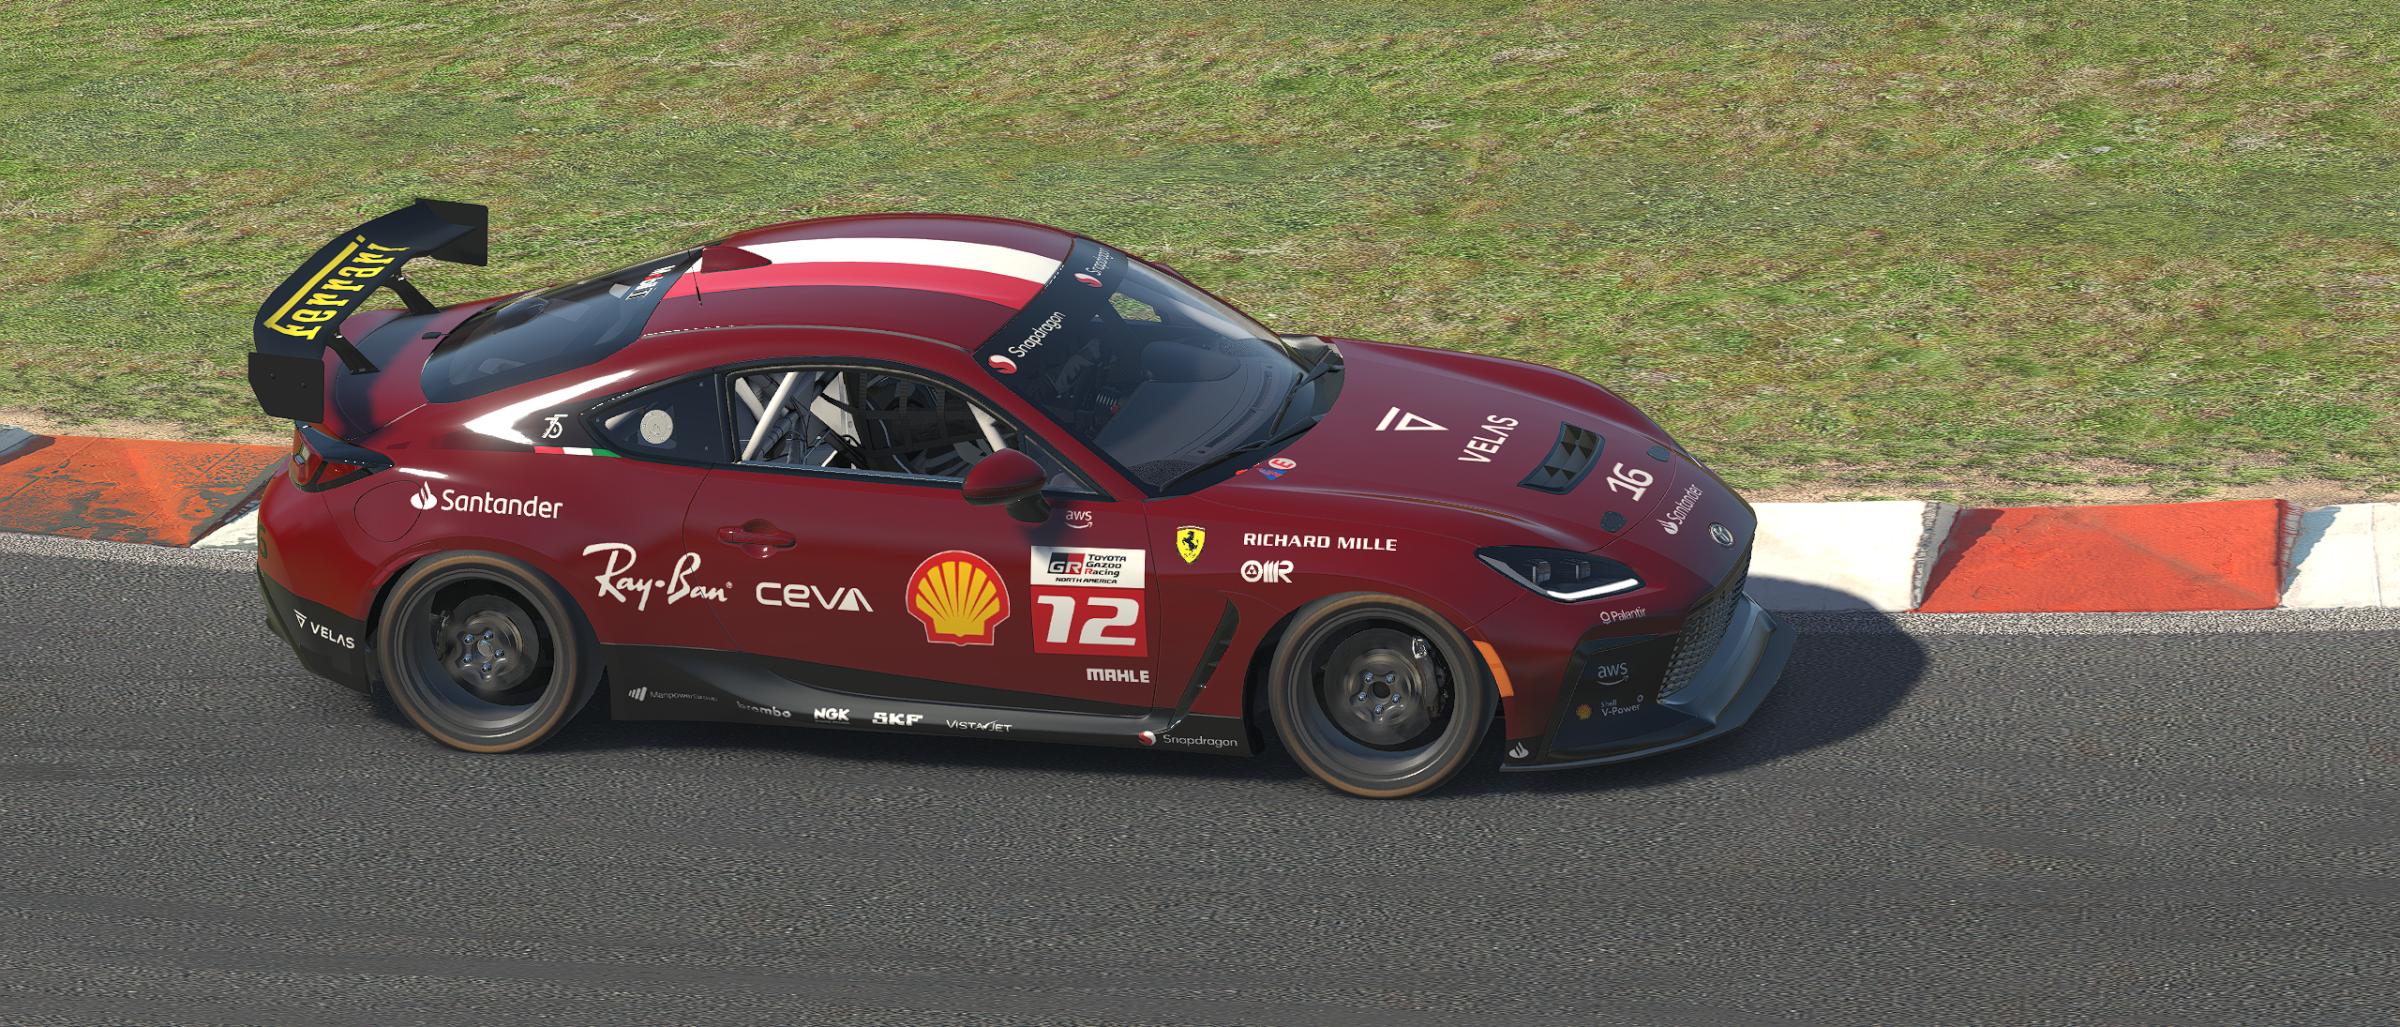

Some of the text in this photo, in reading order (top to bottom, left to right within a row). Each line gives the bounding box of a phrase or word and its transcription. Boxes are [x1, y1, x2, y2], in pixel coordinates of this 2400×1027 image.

[263, 234, 411, 341] Ferrari
[1008, 311, 1066, 358] Snapdragon
[1457, 414, 1520, 463] VELAS
[1605, 462, 1655, 502] 16
[441, 488, 563, 519] Santander
[1671, 484, 1704, 526] Santander
[1066, 510, 1092, 521] aws
[1243, 532, 1398, 551] RICHARD MILLE
[1086, 561, 1122, 569] GAZOO
[1088, 553, 1127, 562] TOYOTA
[1085, 568, 1120, 578] Racing
[1037, 595, 1140, 646] 12
[1611, 606, 1647, 623] Palantir
[309, 622, 355, 649] VELAS
[1086, 667, 1150, 683] MAHLE
[1597, 661, 1629, 679] aws
[813, 707, 850, 721] NGK
[872, 711, 924, 726] SKF
[1601, 704, 1640, 717] V-Power
[1162, 733, 1239, 749] Snapdragon
